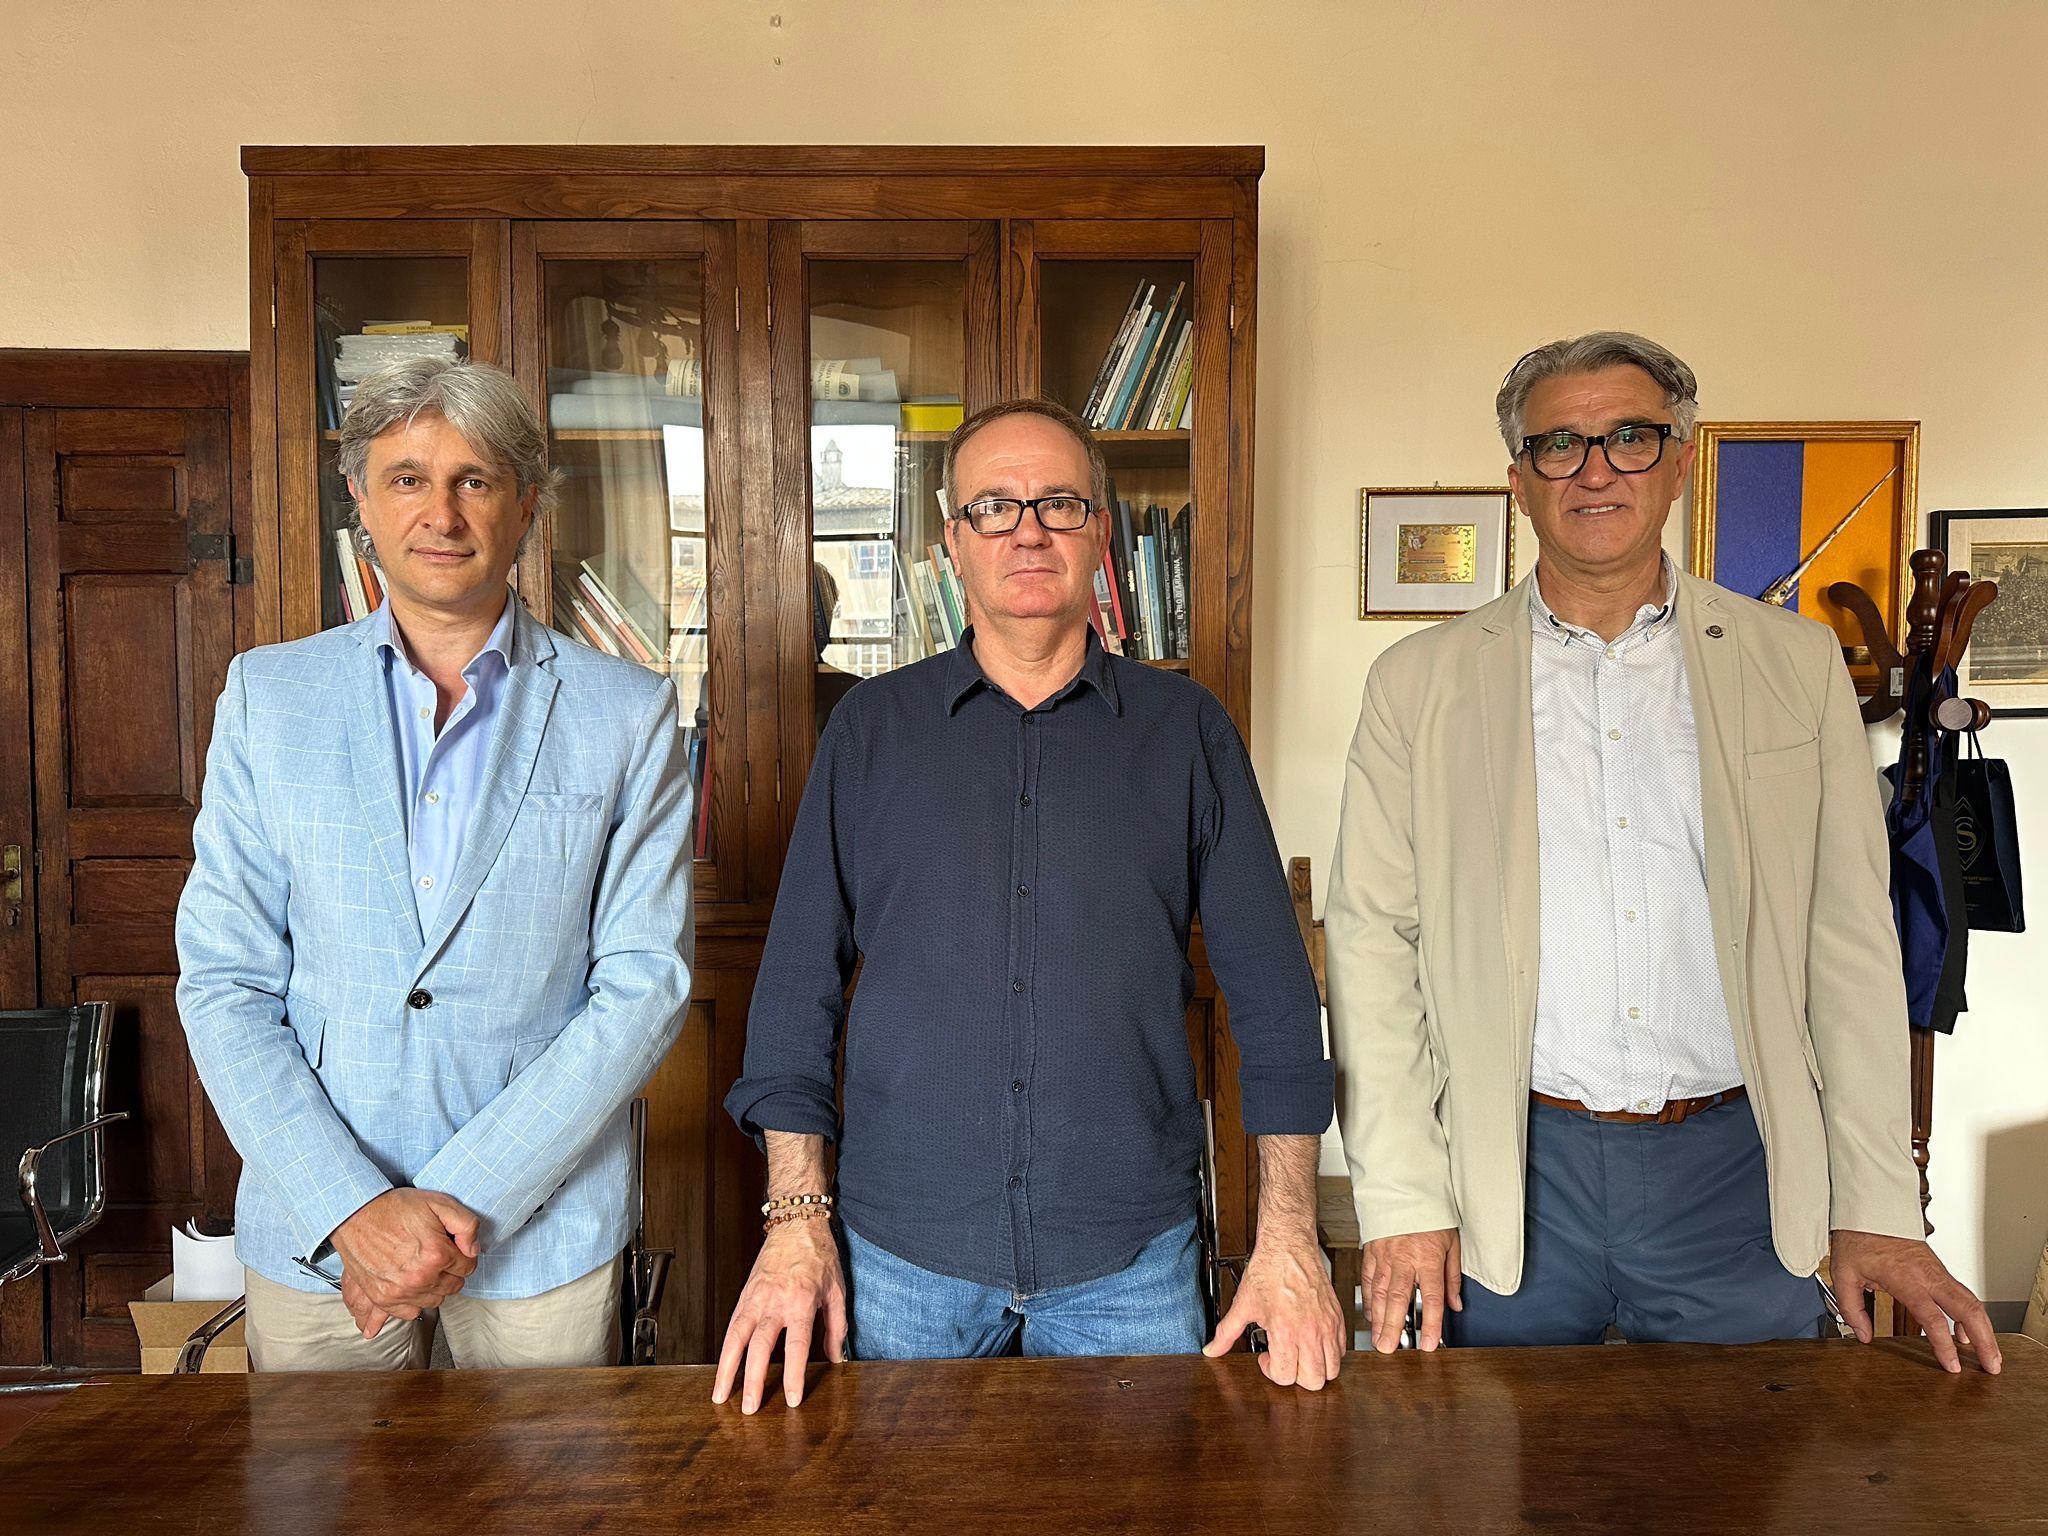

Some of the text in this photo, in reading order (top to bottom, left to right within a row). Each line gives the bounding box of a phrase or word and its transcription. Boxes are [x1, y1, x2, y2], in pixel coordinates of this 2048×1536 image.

[1173, 558, 1181, 590] ARIANNA
[1175, 598, 1183, 612] FILO
[1955, 816, 1977, 851] S
